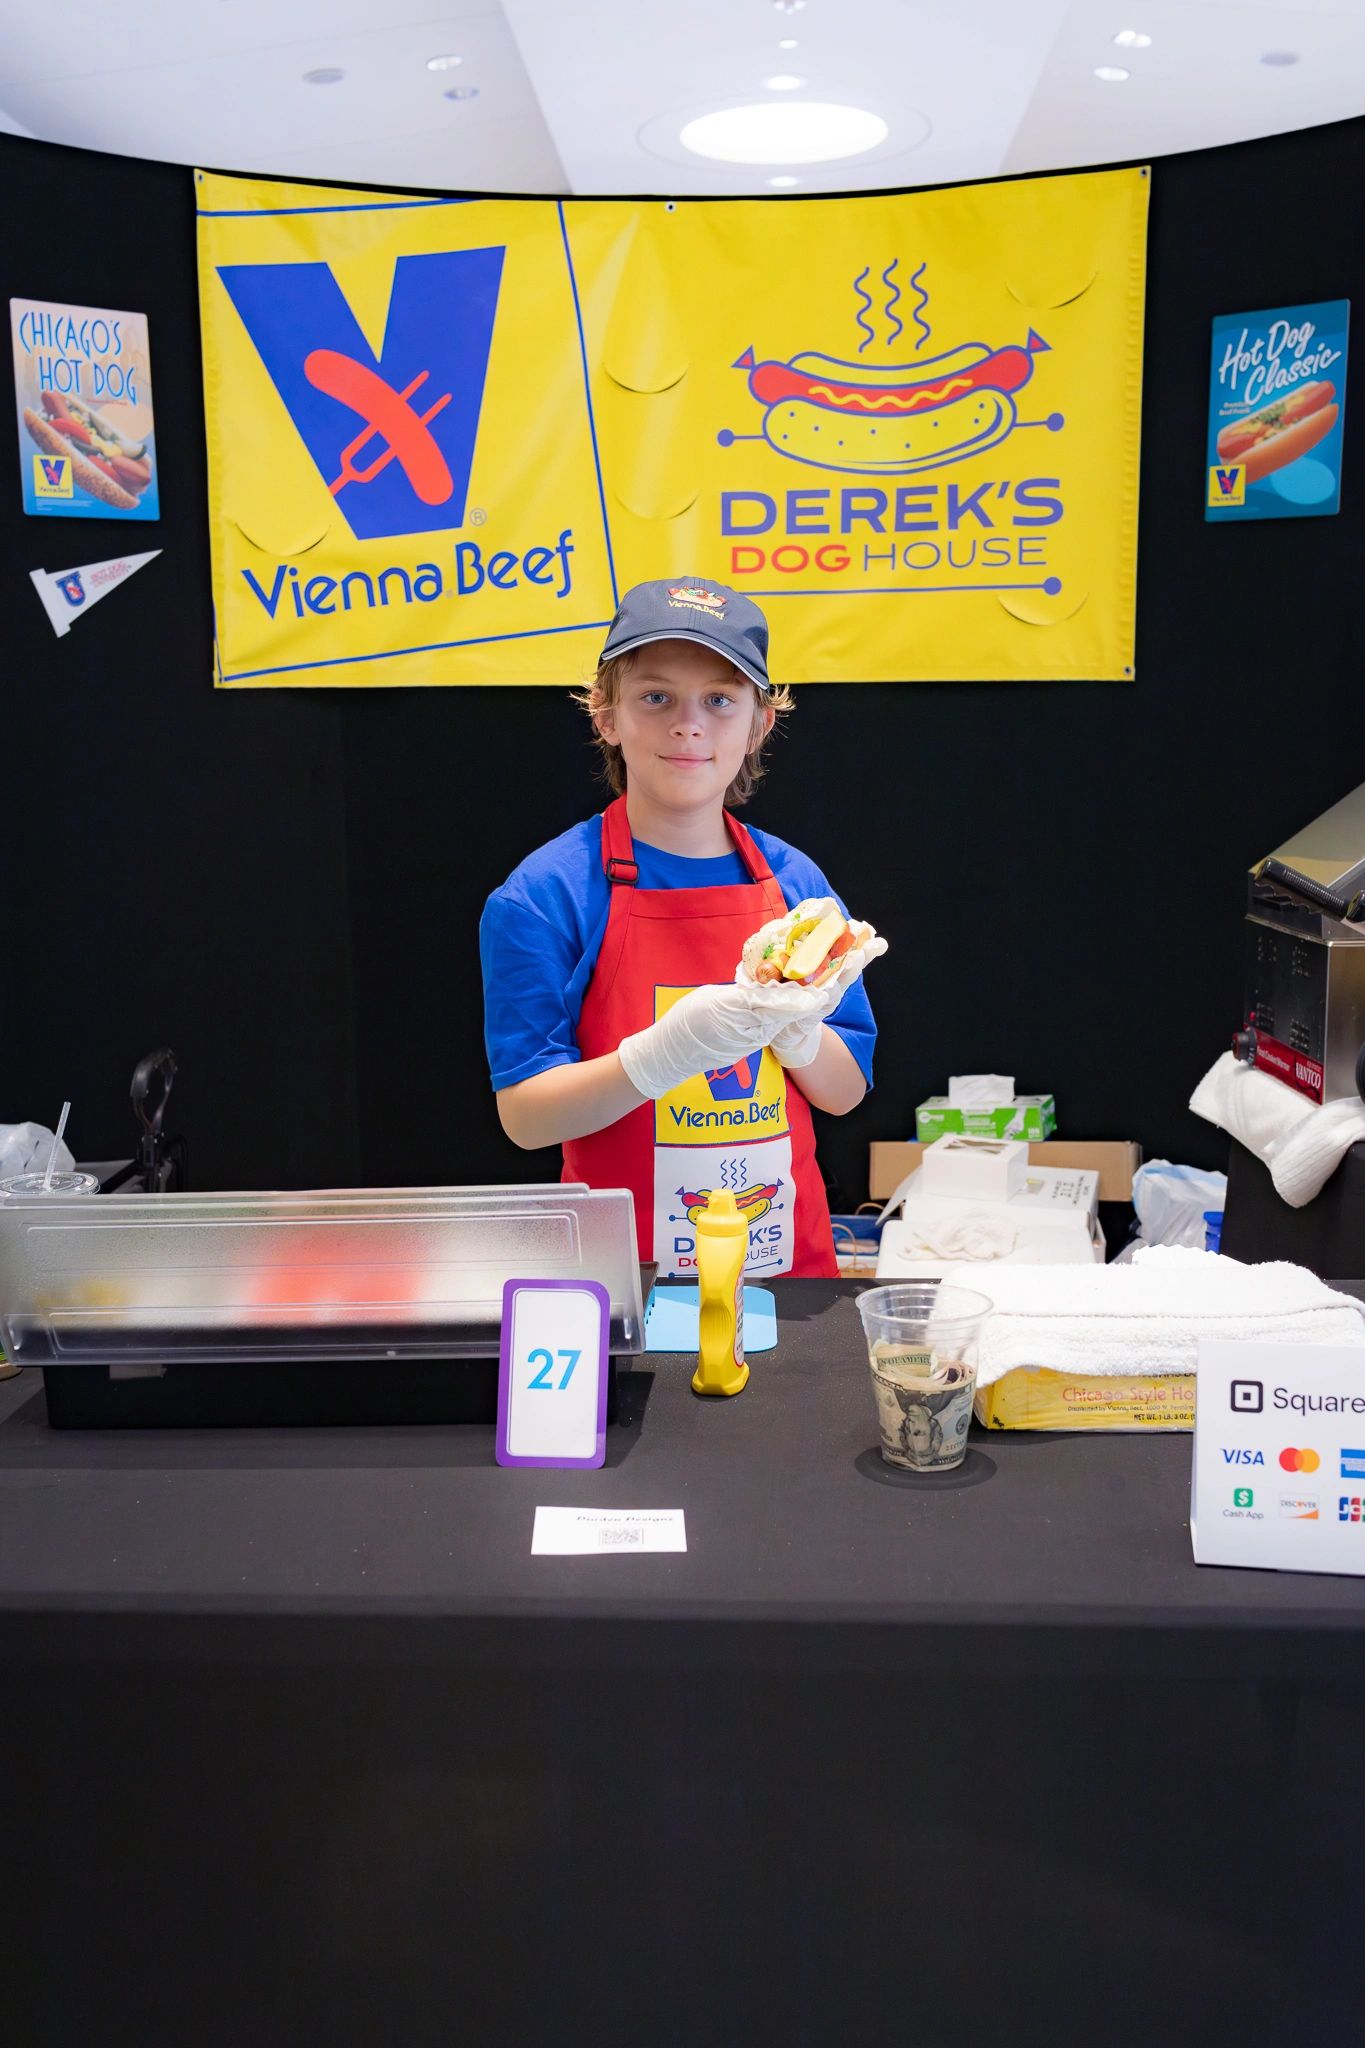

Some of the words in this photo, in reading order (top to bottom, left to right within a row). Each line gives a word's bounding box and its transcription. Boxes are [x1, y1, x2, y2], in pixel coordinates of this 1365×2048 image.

[19, 311, 121, 359] CHICAGO'S
[1219, 328, 1265, 390] Hot
[1267, 320, 1316, 358] Dog
[39, 356, 83, 393] HOT
[93, 363, 137, 406] DOG
[1244, 343, 1342, 405] Classic
[721, 478, 1064, 536] DEREK'S
[731, 544, 851, 574] DOG
[864, 537, 1047, 572] HOUSE
[241, 561, 444, 620] Vienna
[454, 529, 575, 598] Beef
[668, 600, 702, 612] Vienna
[703, 605, 725, 620] Beef
[669, 1105, 745, 1127] Vienna
[749, 1097, 781, 1123] Beef
[674, 1225, 782, 1253] DK'S
[527, 1348, 582, 1390] 27
[1062, 1387, 1124, 1405] Chicago
[1130, 1386, 1167, 1404] Style
[1171, 1386, 1194, 1401] Ho
[1273, 1387, 1365, 1417] Square
[1220, 1449, 1265, 1466] VISA
[1222, 1509, 1244, 1518] Cash
[1246, 1510, 1264, 1520] App
[1281, 1499, 1316, 1508] DISCOVER
[1339, 1497, 1365, 1522] JC
